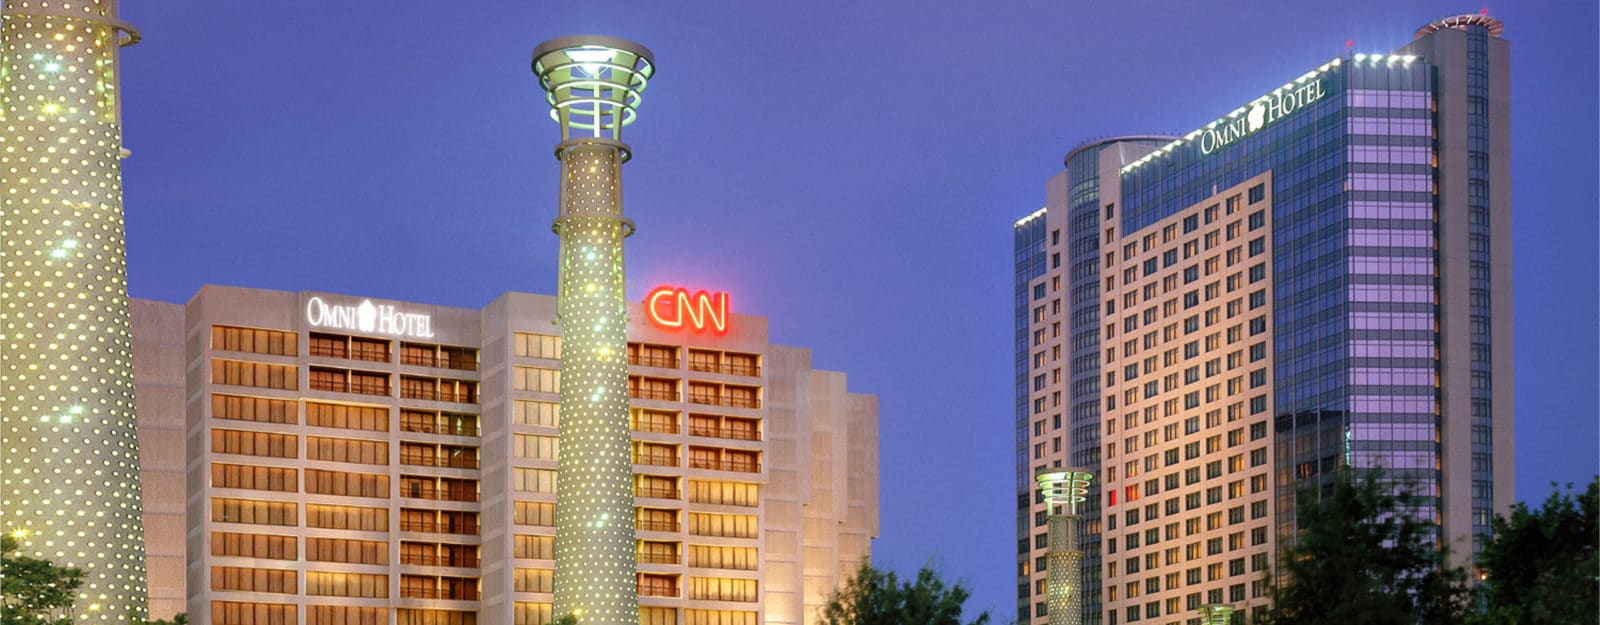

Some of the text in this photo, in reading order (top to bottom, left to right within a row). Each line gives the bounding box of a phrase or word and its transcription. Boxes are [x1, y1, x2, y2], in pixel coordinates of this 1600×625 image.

[1201, 79, 1325, 154] OMNI HOTEL
[307, 297, 434, 337] OMNI HOTEL
[645, 287, 728, 336] CNN
